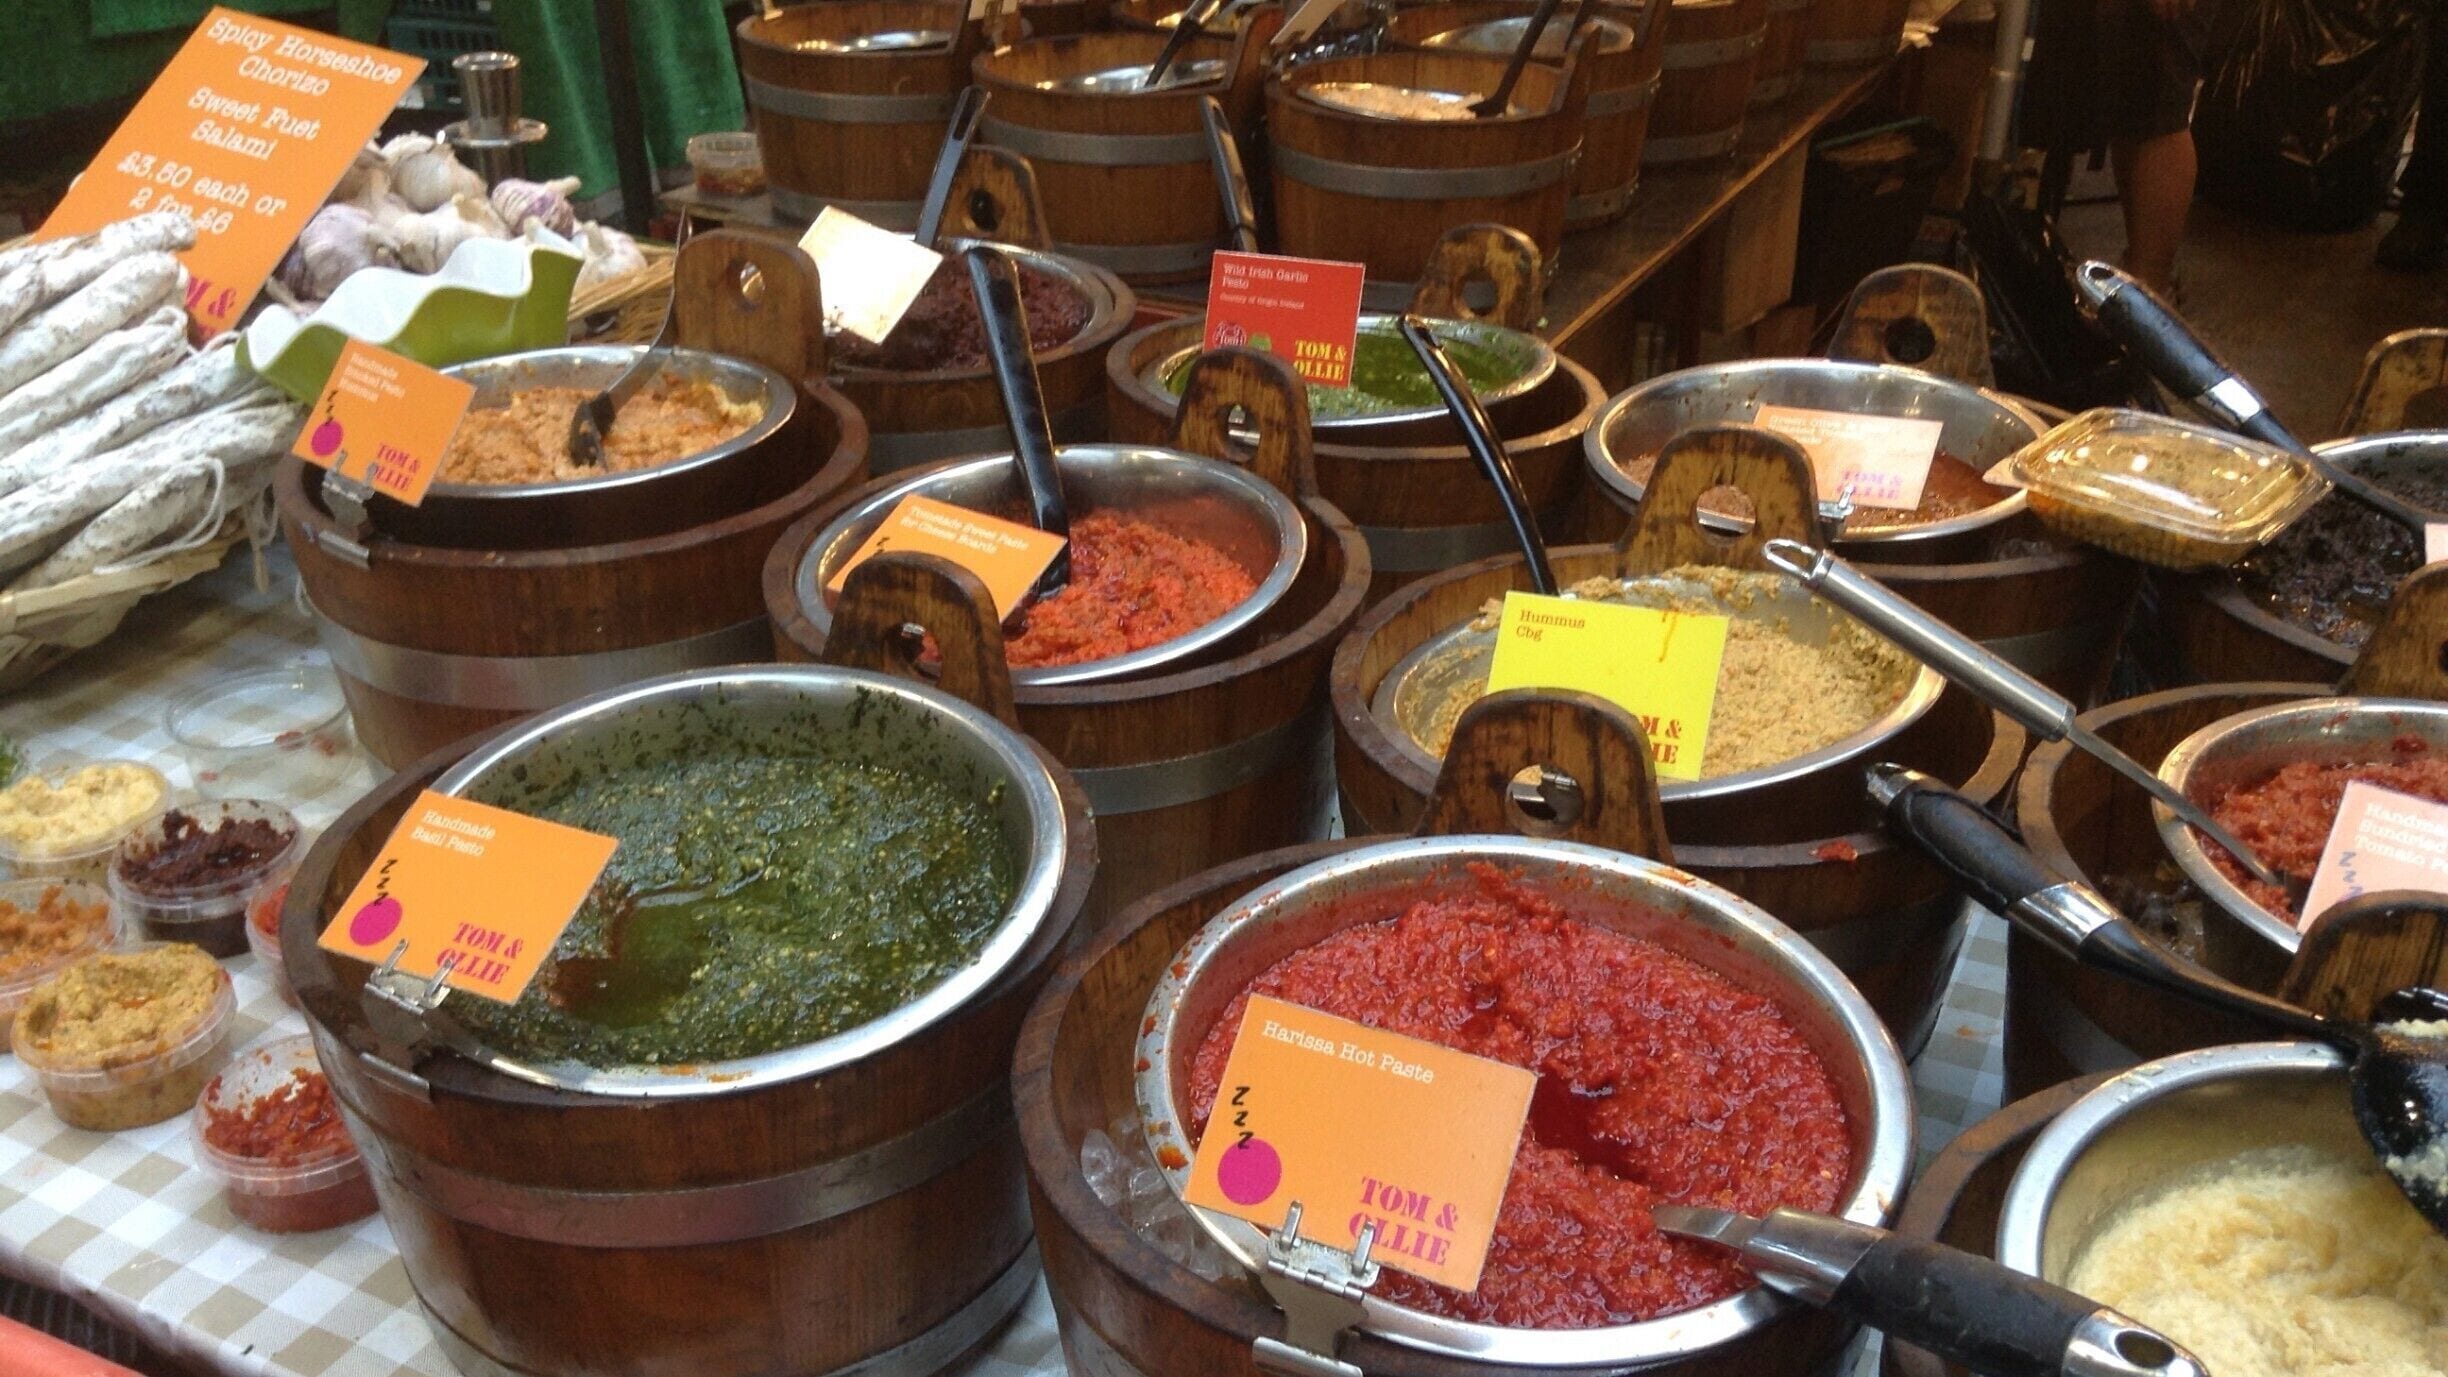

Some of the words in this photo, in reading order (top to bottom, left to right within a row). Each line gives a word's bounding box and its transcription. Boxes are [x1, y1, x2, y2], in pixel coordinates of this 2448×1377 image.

[207, 17, 274, 52] Spicy
[276, 34, 402, 85] Horseshoe
[239, 56, 330, 97] Chorizo
[188, 88, 261, 126] Sweet
[263, 106, 321, 141] Fuet
[191, 119, 278, 161] Salami
[117, 151, 193, 188] £3.50
[193, 177, 250, 208] each
[255, 194, 287, 217] or
[129, 187, 153, 209] 2
[196, 207, 234, 235] £6
[1222, 262, 1246, 276] Wild
[1248, 267, 1273, 279] Irish
[1276, 269, 1309, 284] Garlic
[1222, 276, 1249, 290] Pesto
[1295, 339, 1331, 361] TOM
[1334, 345, 1347, 362] &
[1293, 359, 1345, 381] OLLIE
[377, 442, 410, 469] TOM
[408, 456, 421, 474] &
[375, 465, 411, 493] LLIE
[1516, 626, 1543, 642] Cbg
[1519, 610, 1586, 629] Hummus
[1665, 719, 1683, 740] &
[422, 809, 496, 840] Handmade
[411, 826, 446, 848] Basil
[447, 834, 485, 857] Pesto
[2355, 834, 2426, 866] Tomato
[453, 921, 504, 953] TOM
[504, 938, 524, 960] &
[436, 947, 511, 985] OLLIE
[1262, 1019, 1336, 1057] Harissa
[1338, 1041, 1376, 1067] Hot
[1377, 1054, 1435, 1085] Paste
[1361, 1176, 1434, 1224] TOM
[1435, 1201, 1459, 1232] &
[1349, 1212, 1451, 1267] OLLIE
